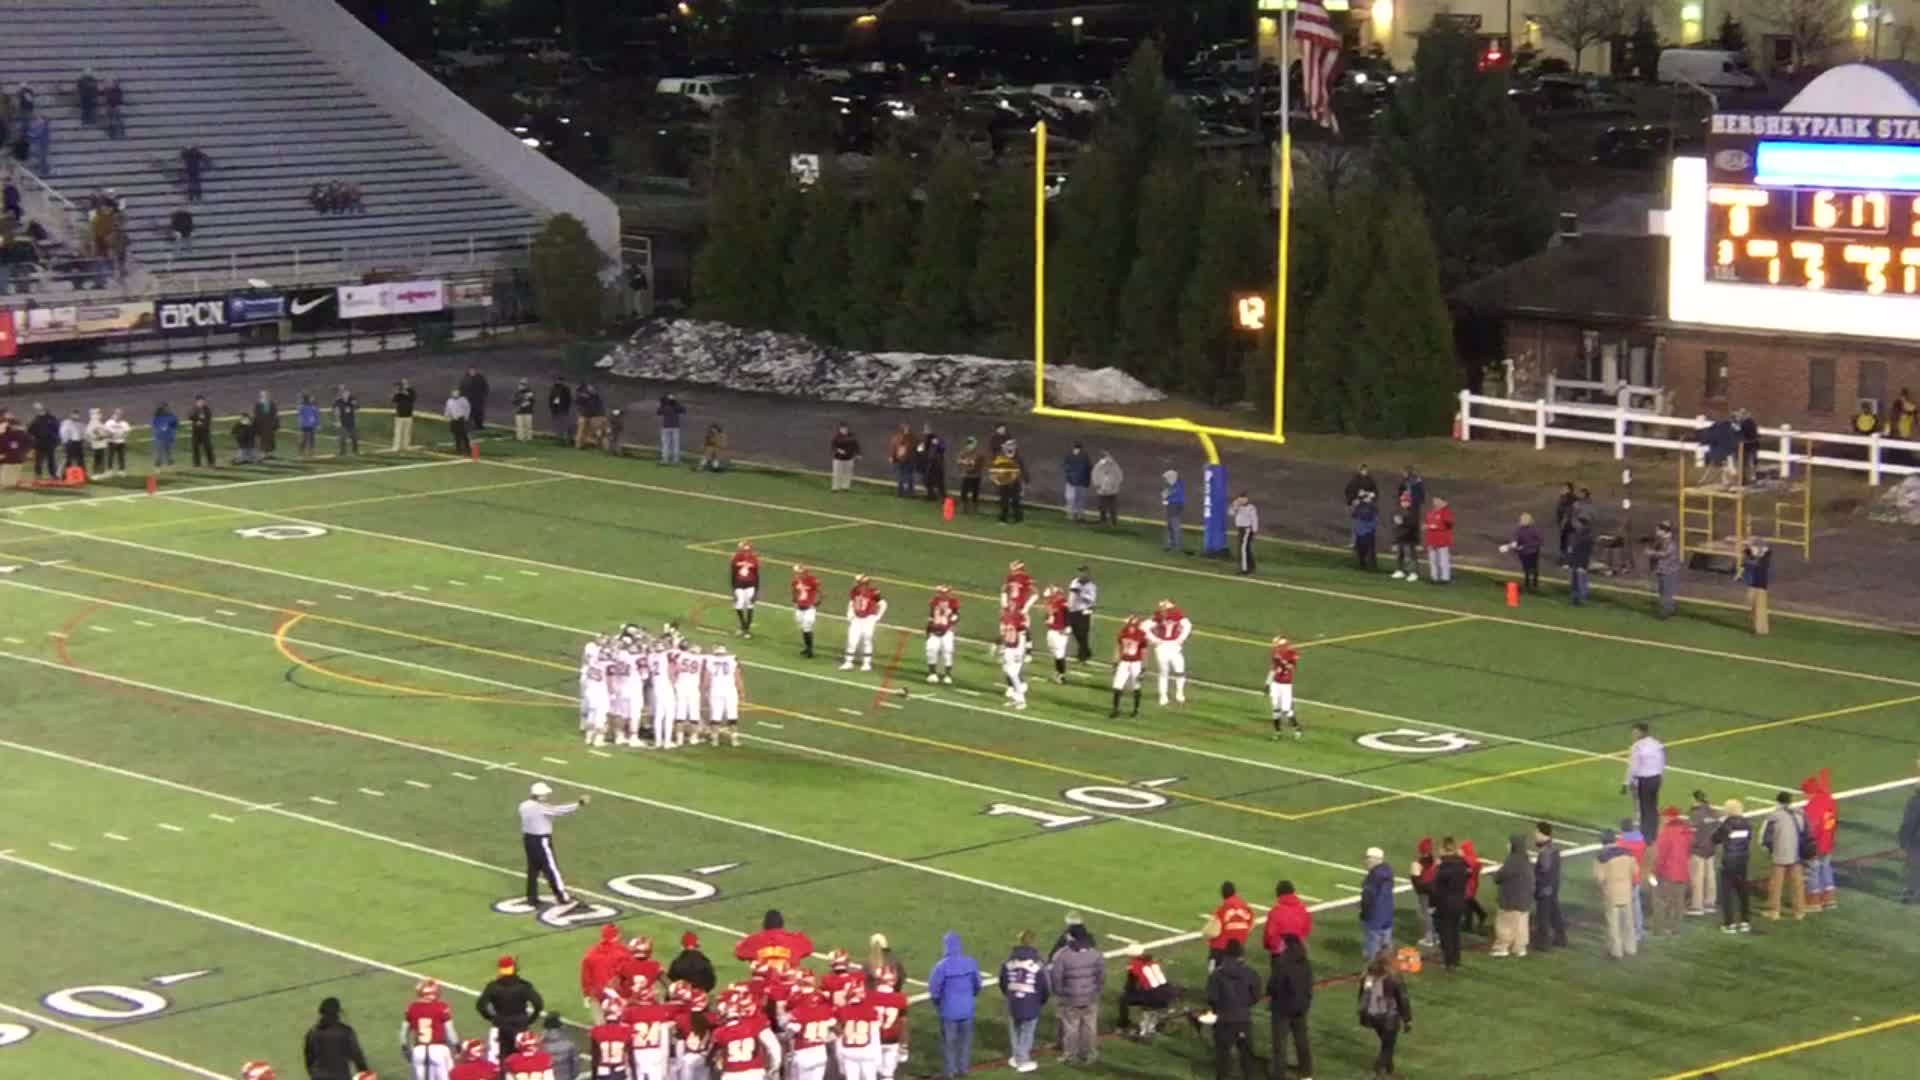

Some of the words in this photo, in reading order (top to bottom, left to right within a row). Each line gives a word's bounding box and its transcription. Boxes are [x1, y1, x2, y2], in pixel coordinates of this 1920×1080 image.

[1711, 114, 1872, 138] HERSHEYPARK
[1356, 728, 1482, 753] G
[987, 785, 1167, 828] 10
[417, 1018, 433, 1044] 5
